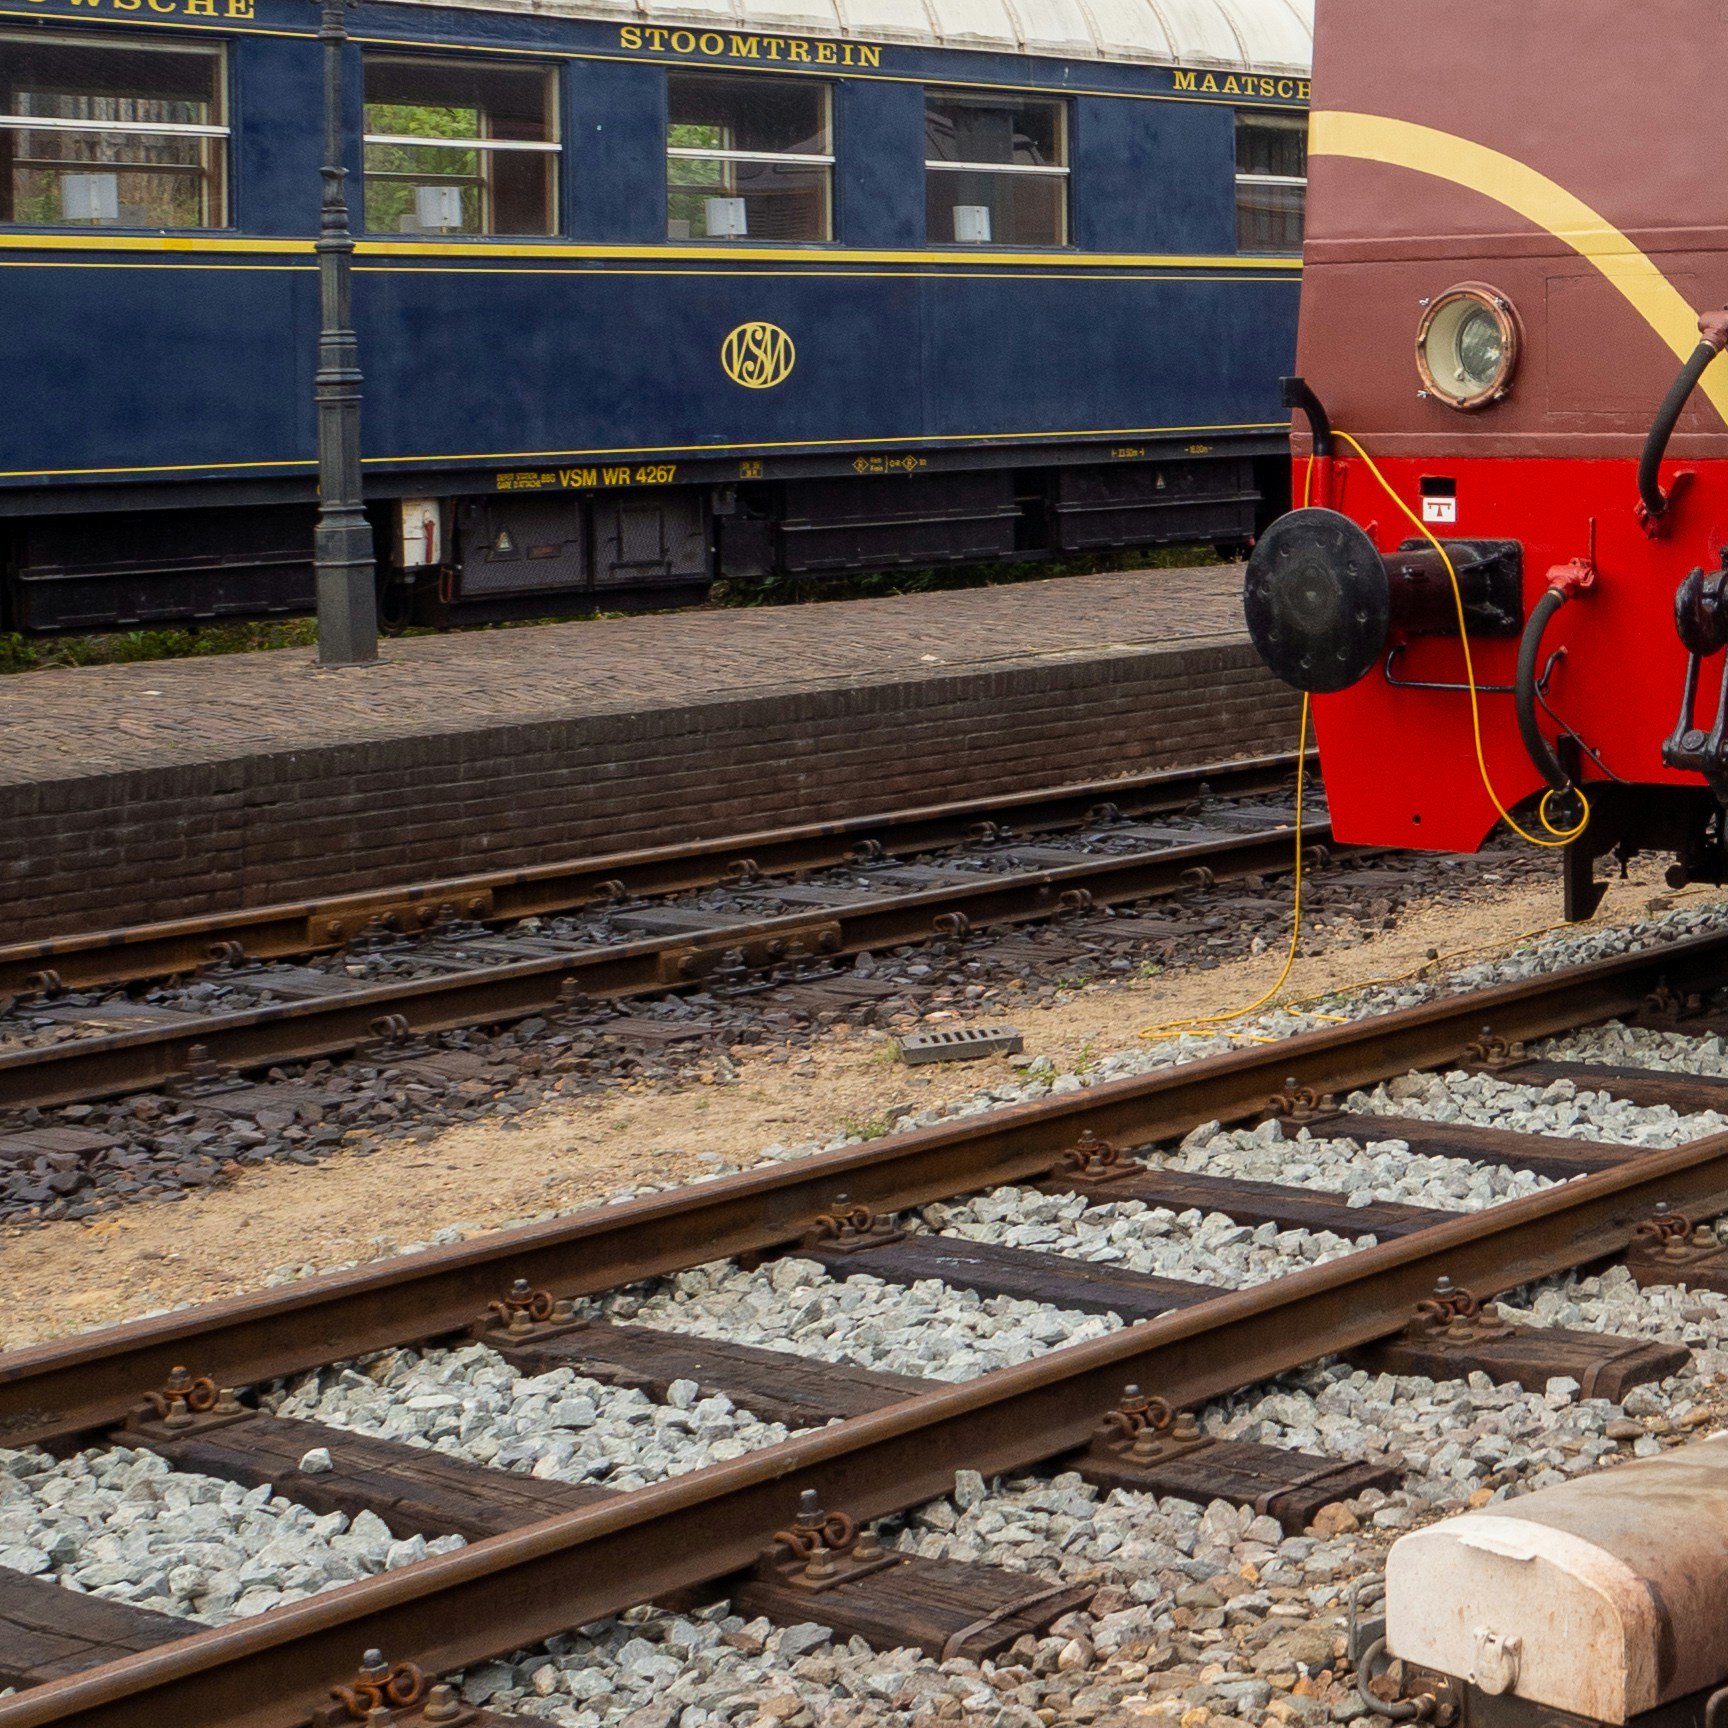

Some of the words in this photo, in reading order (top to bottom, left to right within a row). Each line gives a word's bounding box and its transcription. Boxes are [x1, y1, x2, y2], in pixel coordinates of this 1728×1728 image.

[620, 26, 882, 68] STOOMTREIN
[1172, 70, 1312, 100] MAATSCH
[559, 469, 597, 487] VSM
[602, 467, 631, 485] WR
[635, 465, 677, 483] 4267
